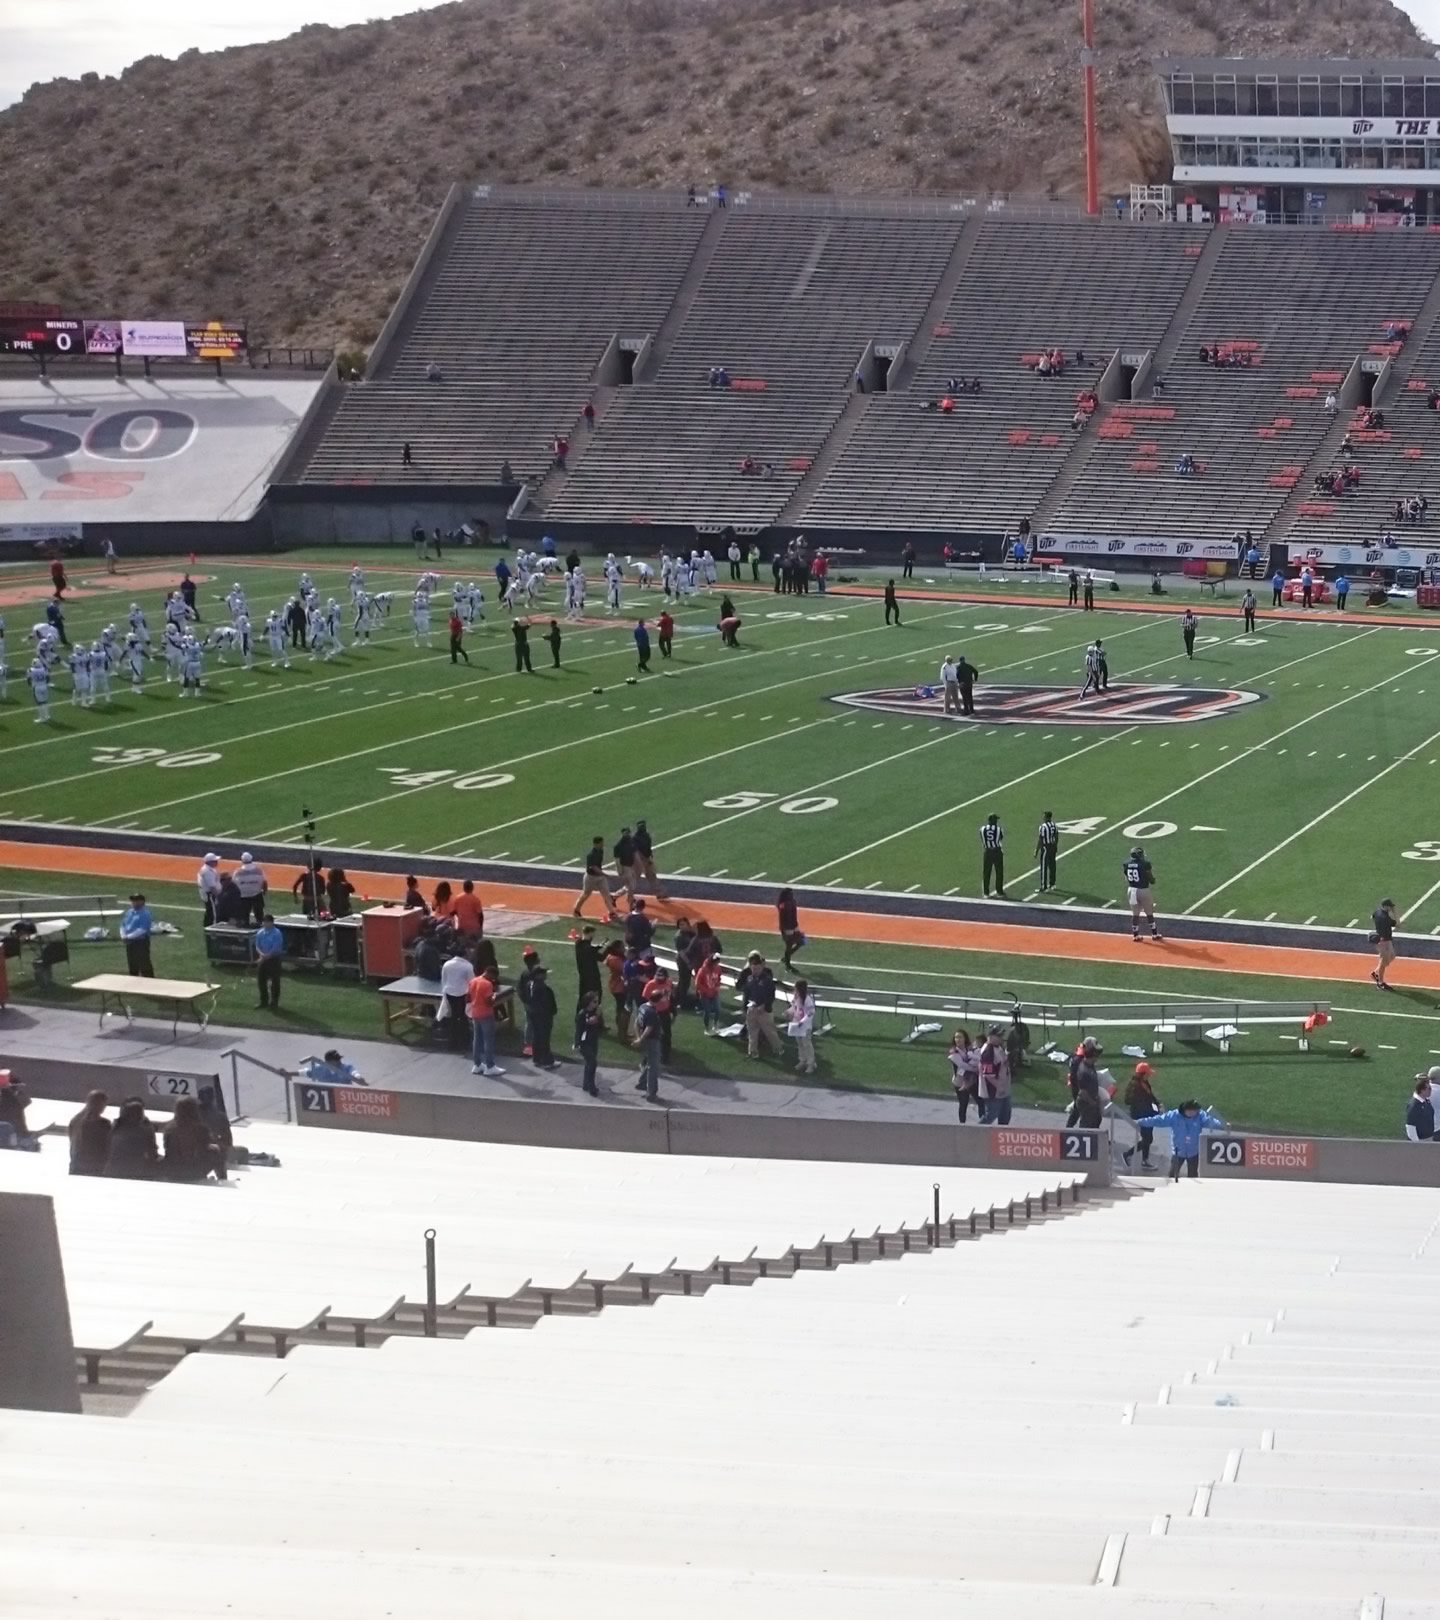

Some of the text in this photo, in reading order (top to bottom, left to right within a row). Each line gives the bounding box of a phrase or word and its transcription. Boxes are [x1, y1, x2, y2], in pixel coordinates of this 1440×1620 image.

[1395, 120, 1430, 135] THE
[46, 321, 78, 329] MINERS
[13, 341, 34, 350] PRE
[56, 333, 71, 350] 0
[91, 747, 222, 768] 30
[390, 769, 516, 790] 40
[703, 791, 839, 814] 50
[1054, 816, 1178, 839] 40
[1127, 869, 1140, 883] 59
[167, 1078, 191, 1095] 22
[307, 1088, 389, 1111] 21 STUDENT
[341, 1102, 392, 1117] SECTION
[997, 1131, 1054, 1146] STUDENT
[1065, 1136, 1094, 1158] 21
[999, 1144, 1053, 1158] SECTION
[1211, 1141, 1308, 1164] 20 STUDENT
[1252, 1153, 1307, 1167] SECTION
